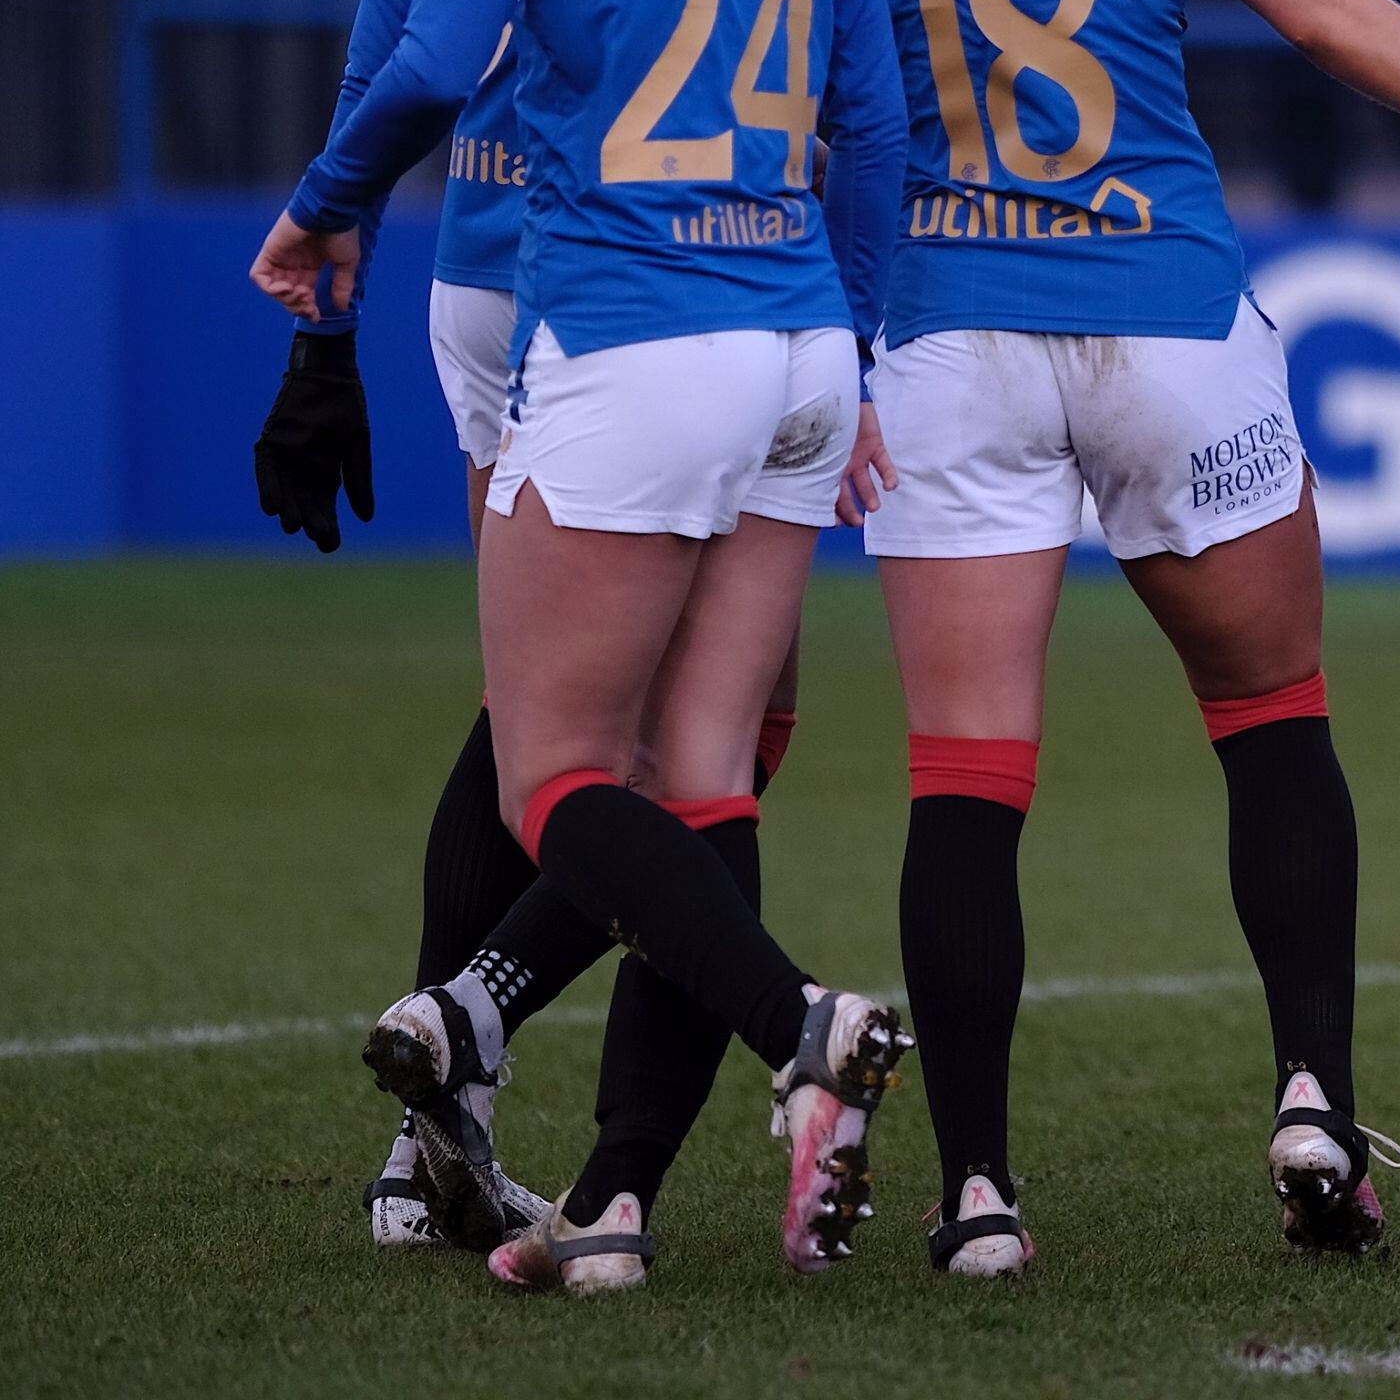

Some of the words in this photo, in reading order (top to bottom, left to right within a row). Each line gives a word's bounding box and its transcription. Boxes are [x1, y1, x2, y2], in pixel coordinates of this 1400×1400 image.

[672, 201, 784, 245] utilita
[909, 188, 1091, 239] utilita
[1190, 409, 1284, 478] MOLTON
[1192, 439, 1292, 509] BROWN
[1215, 482, 1282, 515] LONDON
